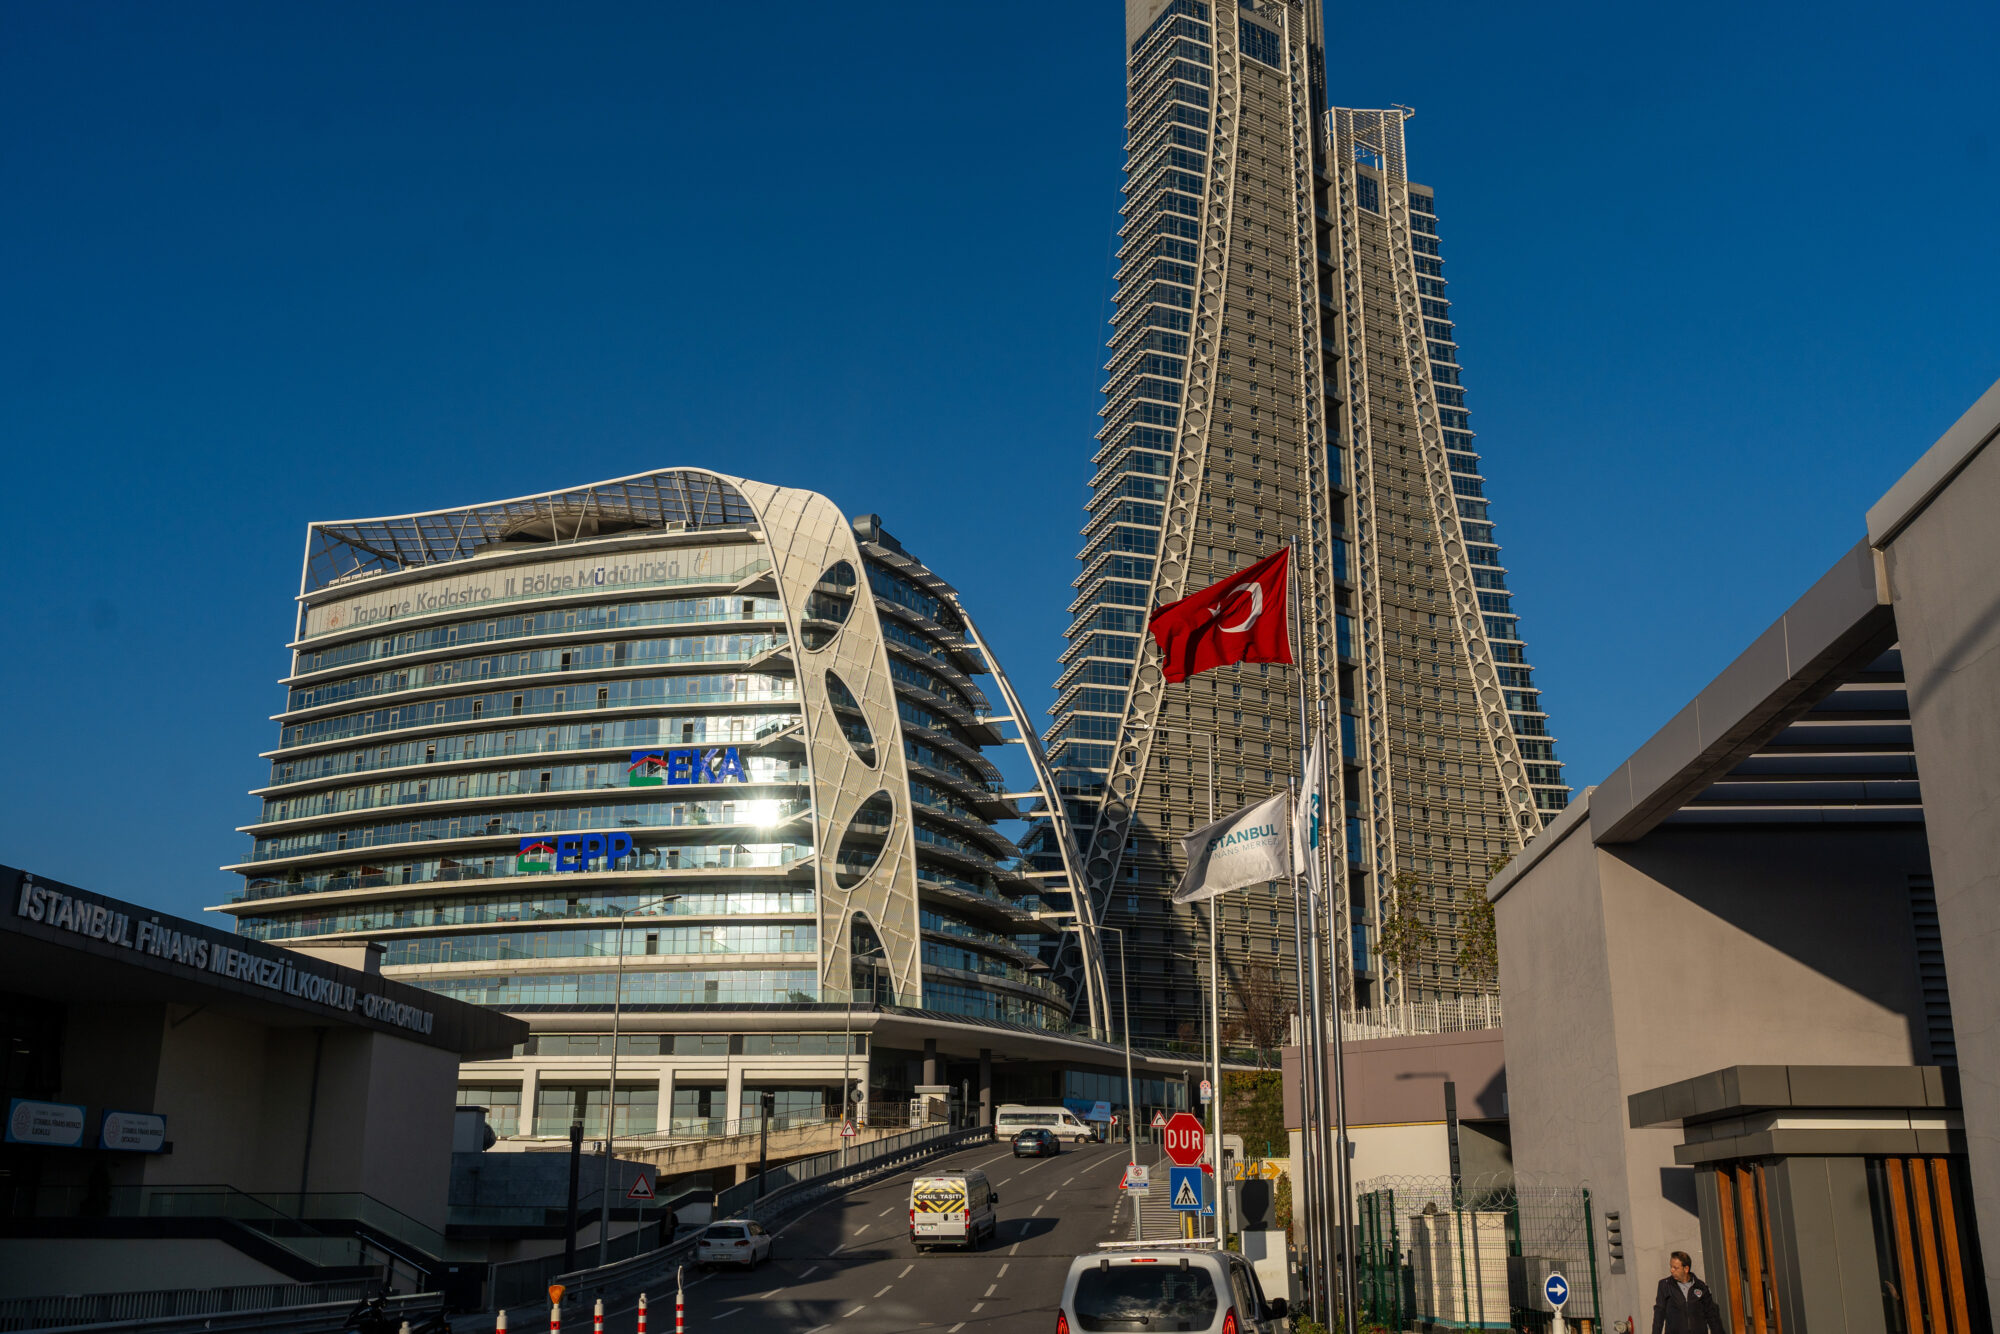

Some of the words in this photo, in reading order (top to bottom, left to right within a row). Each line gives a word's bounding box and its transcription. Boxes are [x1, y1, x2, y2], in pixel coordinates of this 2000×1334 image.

[353, 605, 387, 624] Tapu
[393, 600, 411, 615] ve
[416, 586, 492, 611] Kadastro
[522, 573, 573, 594] Bölge
[578, 561, 680, 587] Müdürlüğü
[667, 747, 748, 785] EKA
[556, 832, 633, 871] EPP
[17, 873, 133, 949] İSTANBUL
[134, 917, 208, 970] FİNANS
[208, 943, 286, 991] MERKEZİ
[283, 960, 357, 1012] İLKOKULU
[363, 992, 434, 1036] ORTAOKULU
[1167, 1129, 1202, 1150] DUR
[1234, 1161, 1260, 1181] 24
